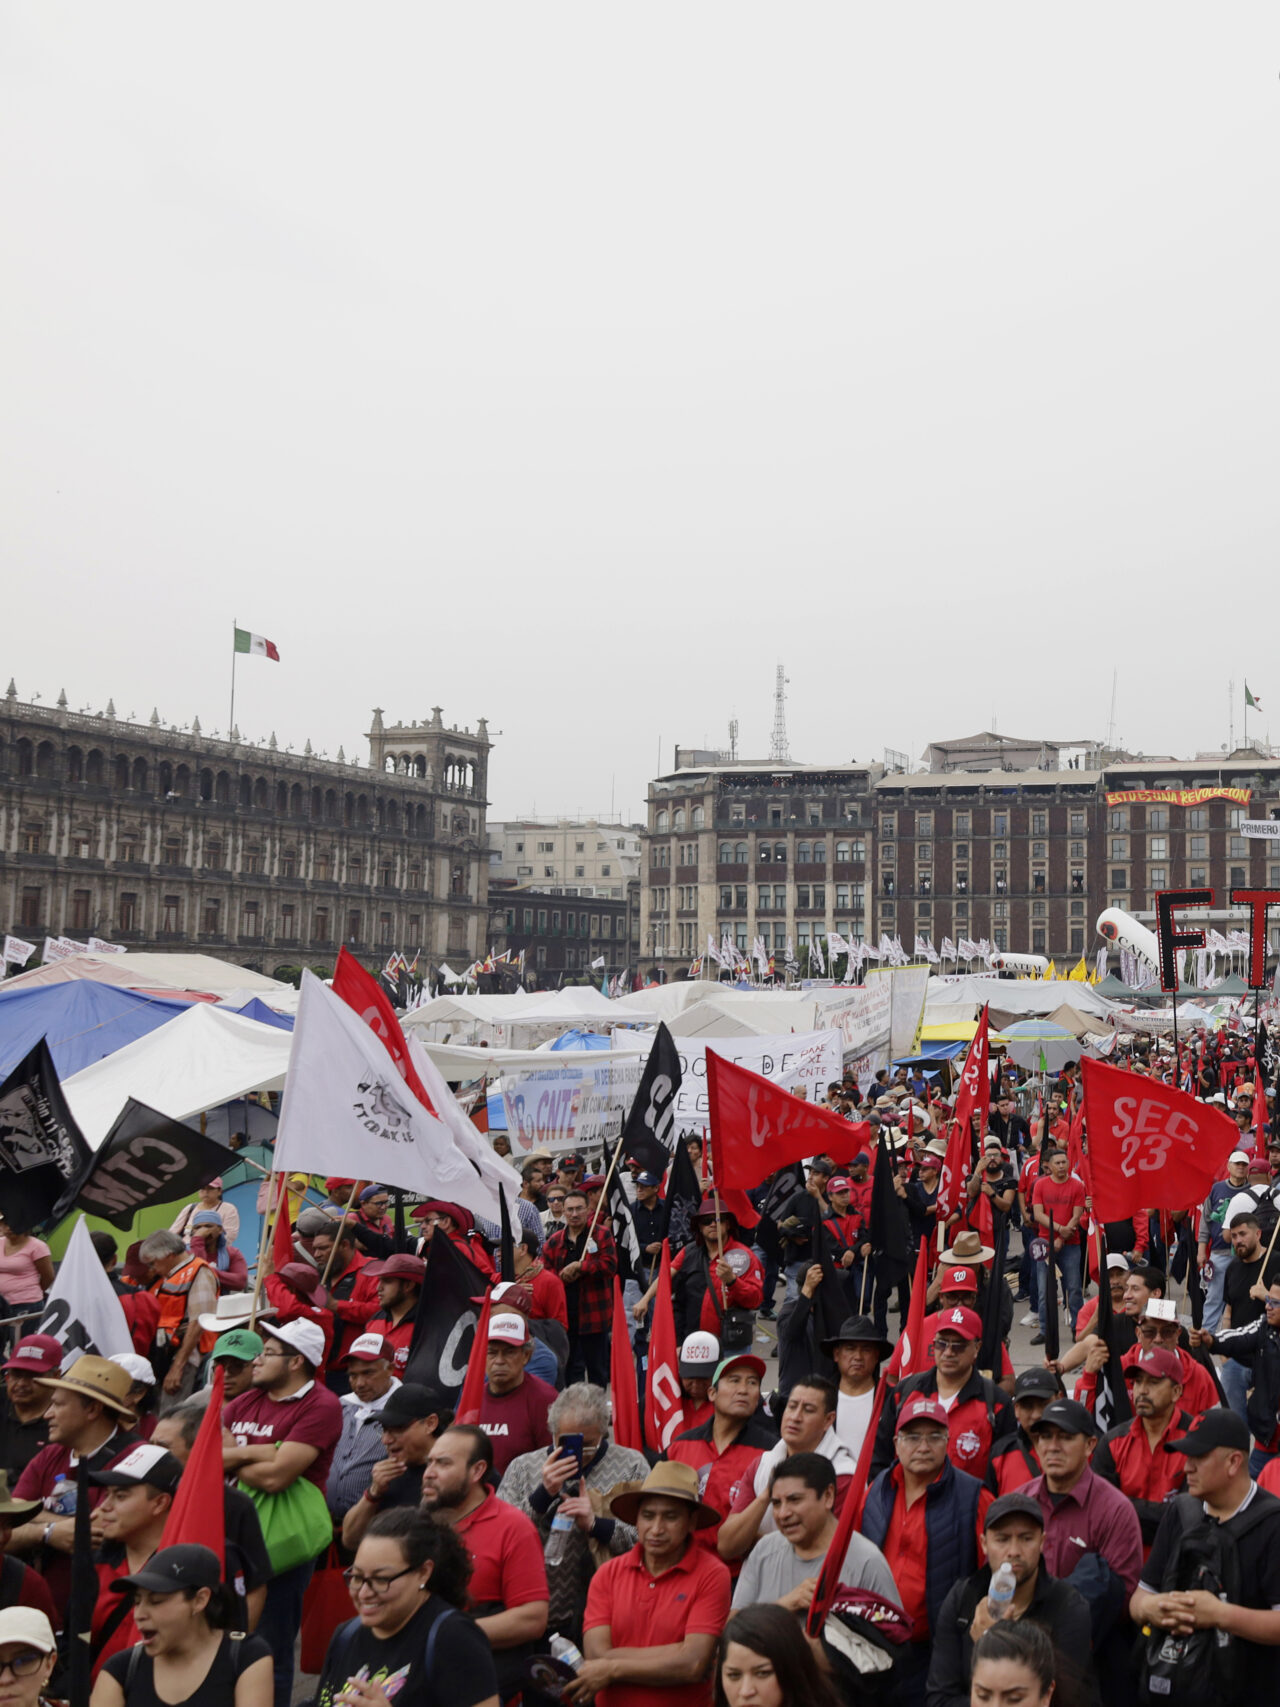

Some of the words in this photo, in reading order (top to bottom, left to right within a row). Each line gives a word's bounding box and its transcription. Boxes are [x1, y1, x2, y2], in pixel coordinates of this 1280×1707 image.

[1240, 823, 1279, 835] PRIMERO
[798, 1066, 828, 1078] CNTE
[536, 1088, 581, 1143] CNTE
[1120, 1133, 1172, 1178] 23
[685, 1345, 711, 1360] SEC-23
